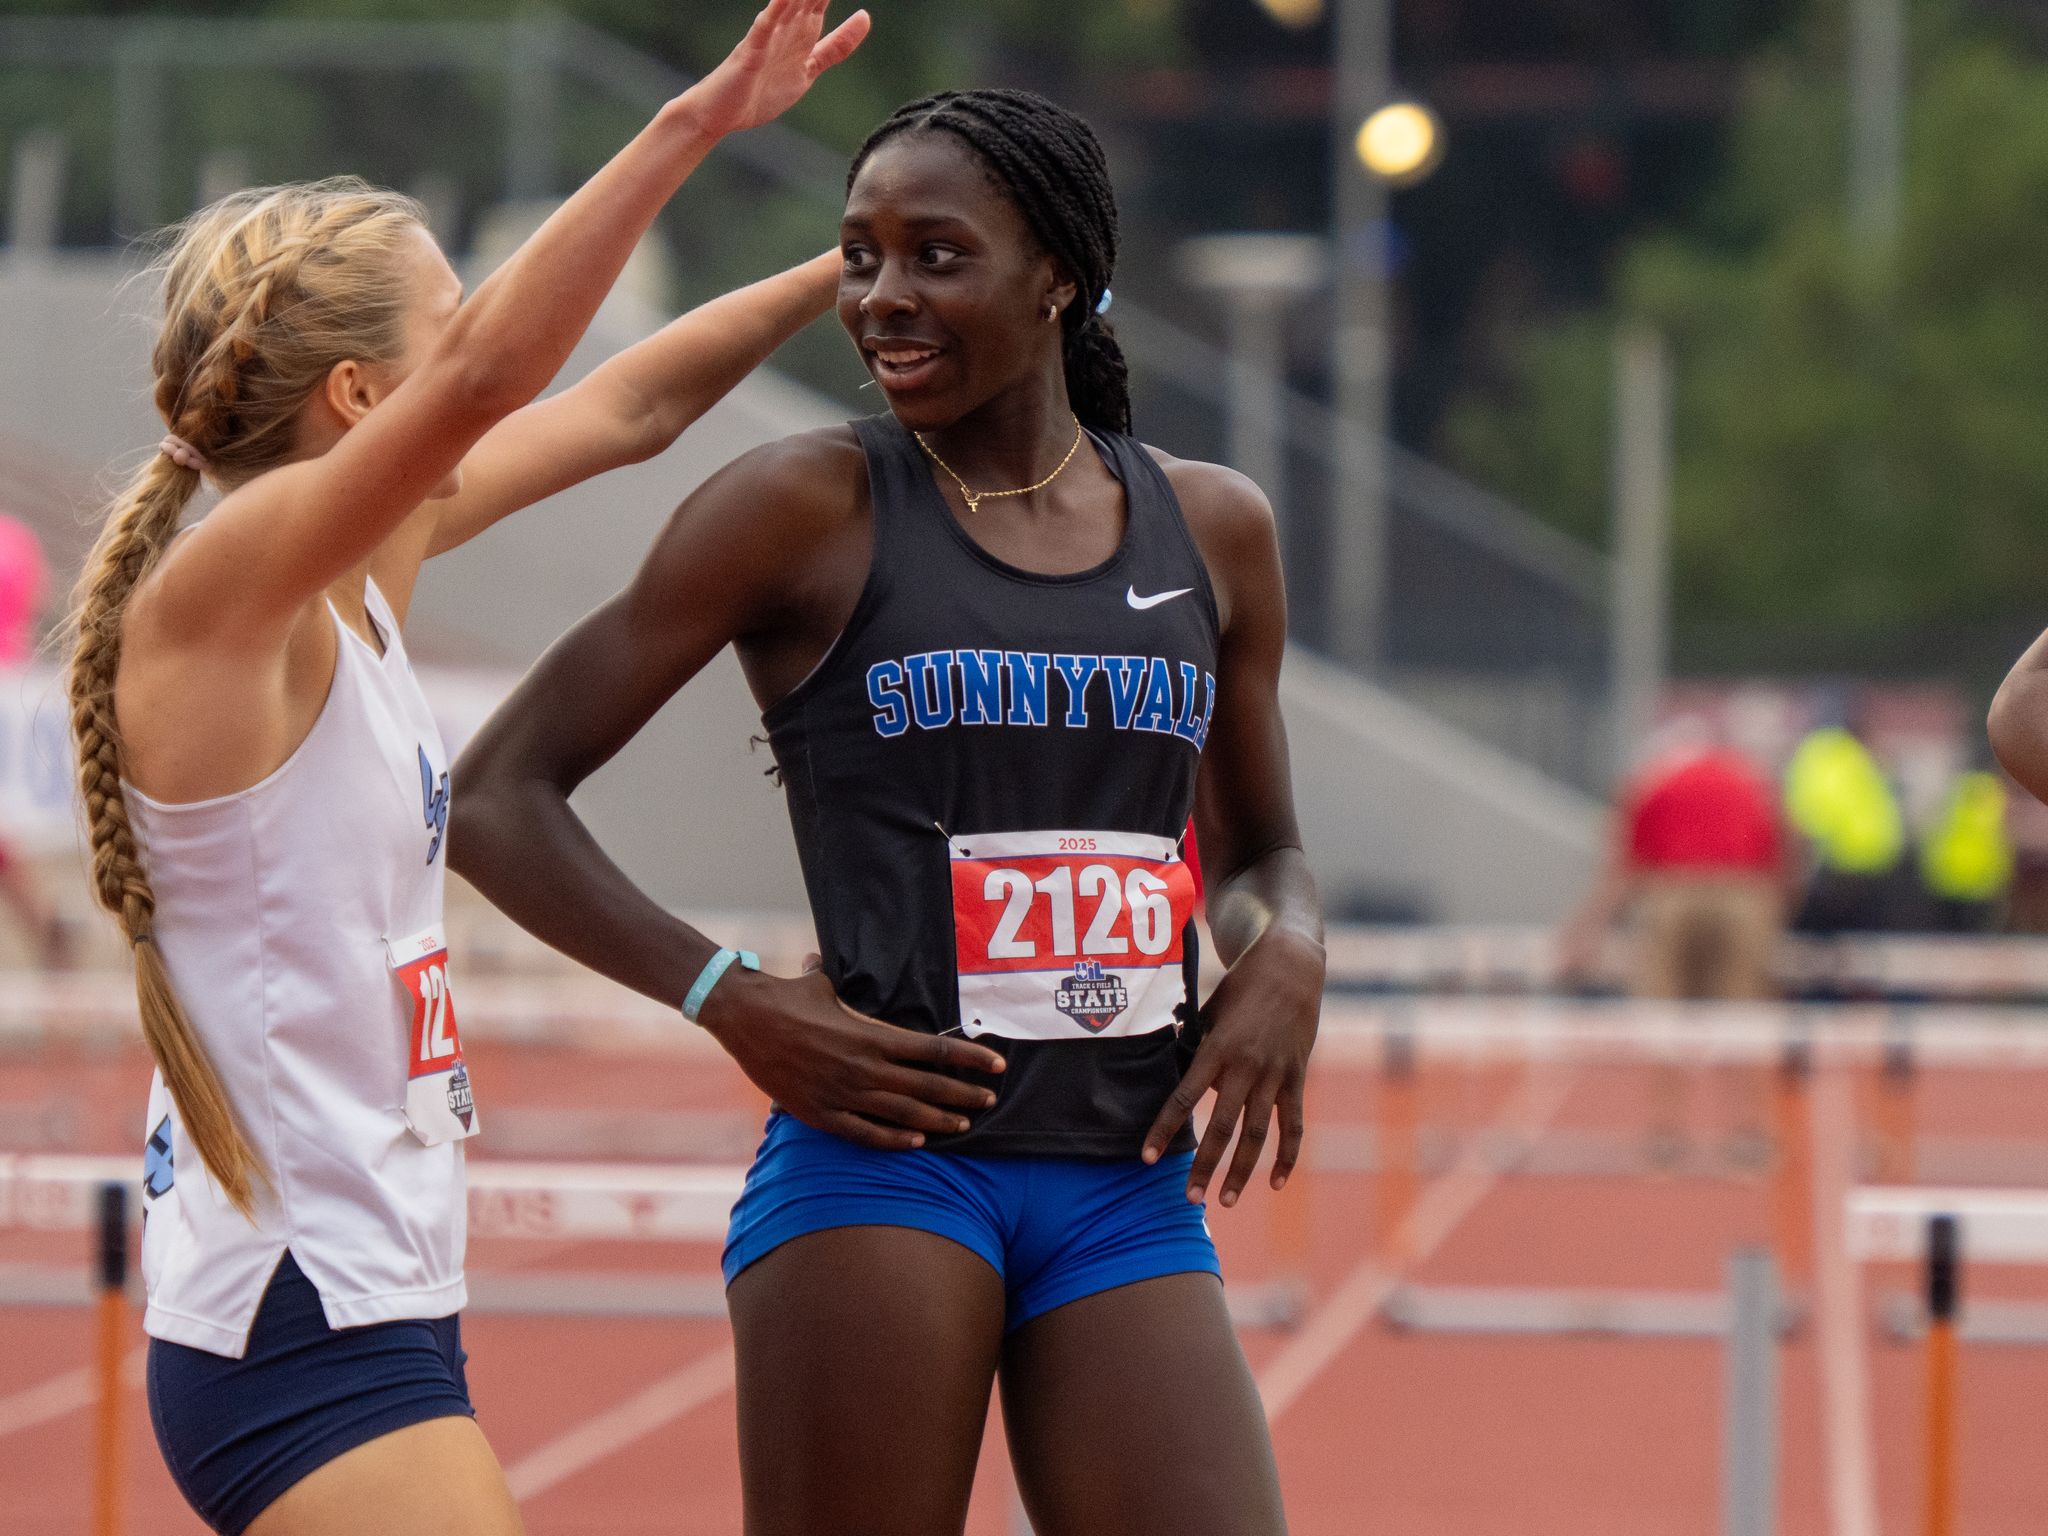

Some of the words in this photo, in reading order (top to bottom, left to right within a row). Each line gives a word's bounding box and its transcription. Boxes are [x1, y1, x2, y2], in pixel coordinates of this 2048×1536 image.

[1058, 837, 1097, 851] 2025
[983, 864, 1172, 960] 2126
[419, 961, 460, 1061] 12
[1057, 989, 1126, 1008] STATE
